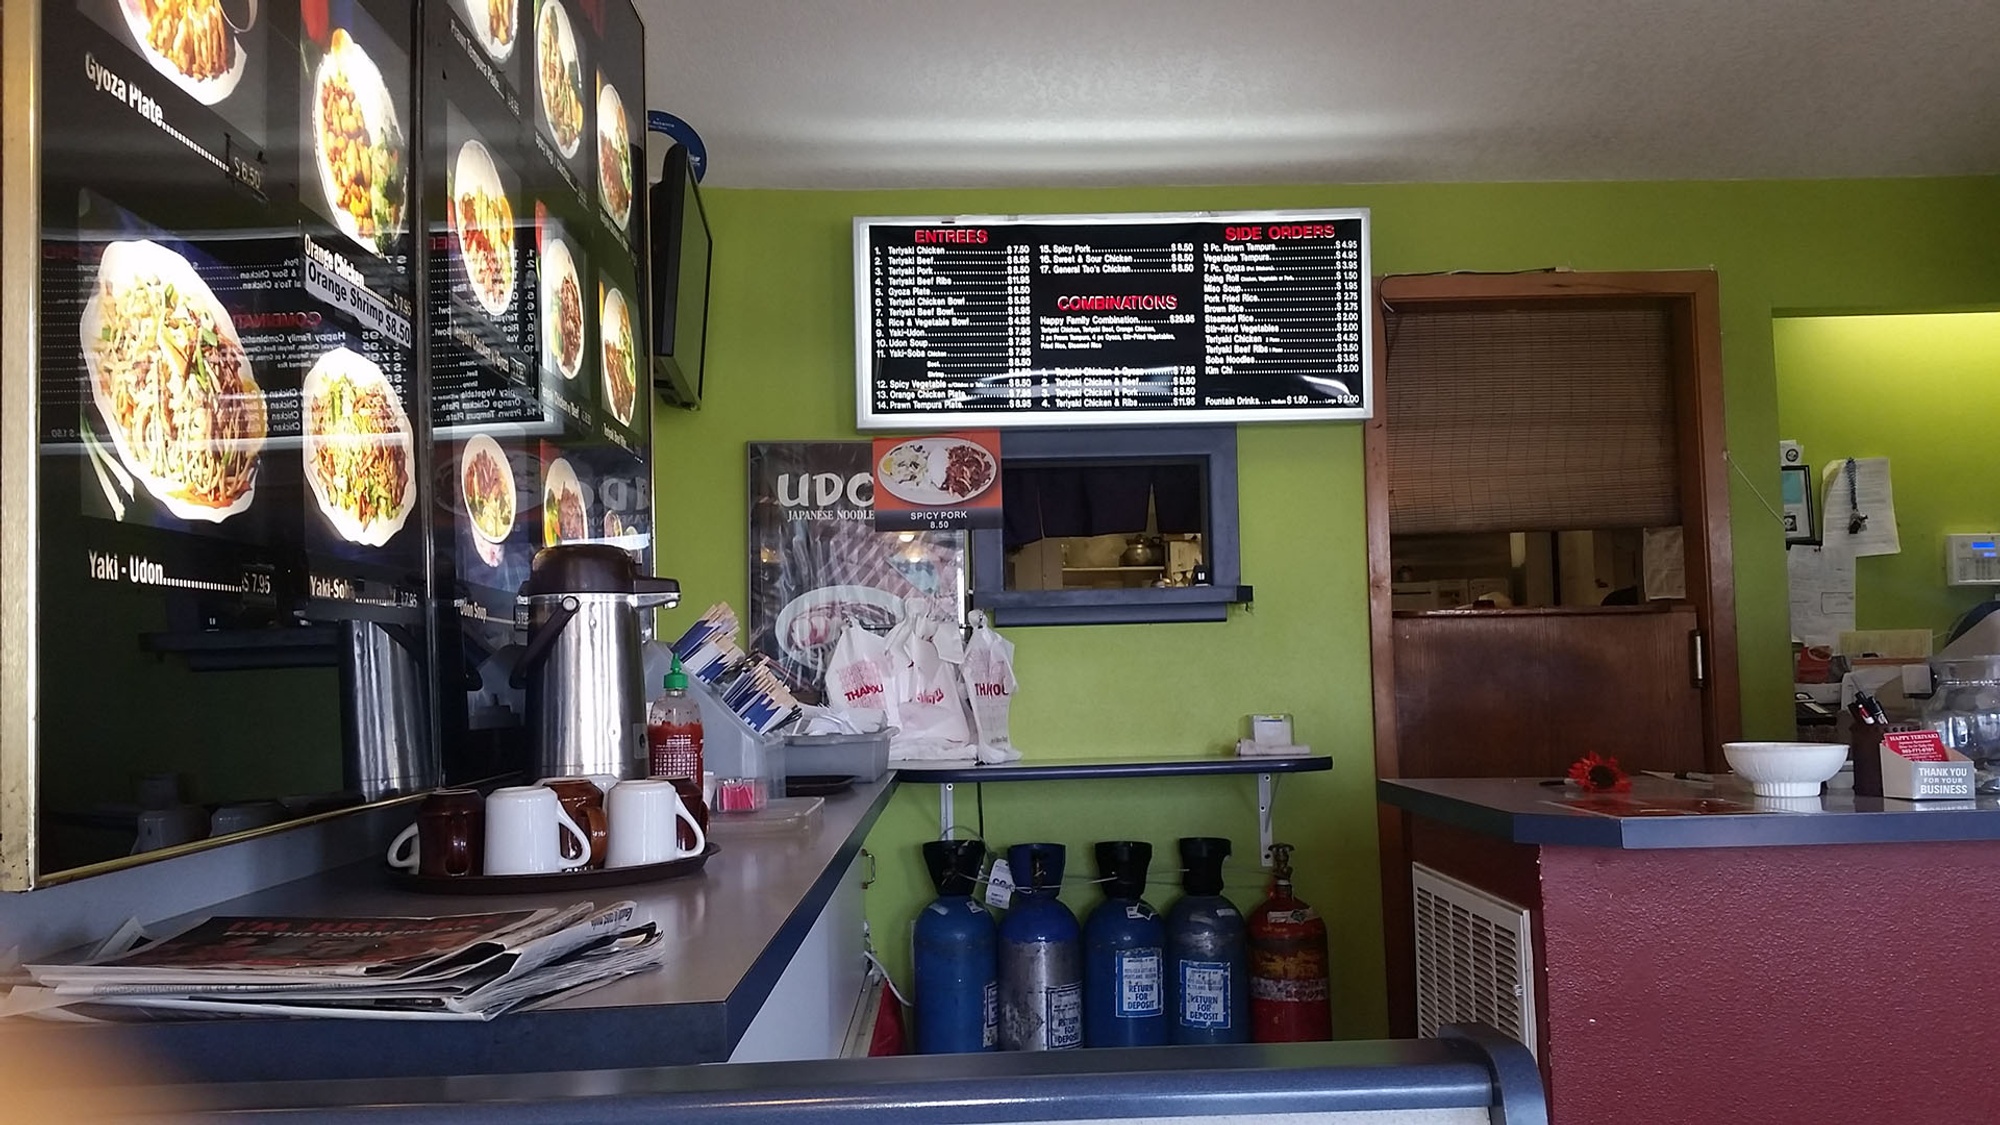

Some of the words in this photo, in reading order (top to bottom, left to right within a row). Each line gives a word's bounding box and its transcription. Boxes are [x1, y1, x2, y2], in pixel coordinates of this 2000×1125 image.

[85, 53, 127, 104] Gyoza
[129, 82, 163, 127] Plate
[914, 230, 988, 243] ENTREES
[1225, 227, 1261, 241] SIDE
[1269, 225, 1335, 239] ORDERS
[304, 234, 334, 271] Orange
[334, 253, 364, 290] Chicken
[309, 262, 347, 302] Orange
[350, 288, 384, 326] Shrimp
[386, 314, 410, 344] $8.50
[1058, 296, 1177, 310] COMBINATIONS
[788, 509, 834, 522] JAPANESE
[910, 511, 939, 522] SPICY
[941, 510, 968, 520] PORK
[930, 520, 950, 530] 8.50
[88, 550, 118, 580] Yaki
[130, 556, 164, 585] Udon
[1918, 767, 1948, 777] THANK
[1950, 767, 1968, 776] YOU
[1920, 784, 1968, 795] BUSINESS
[1128, 984, 1154, 993] RETURN
[1127, 1001, 1155, 1010] DEPOSIT
[1191, 996, 1218, 1005] RETURN
[1190, 1012, 1219, 1021] DEPOSIT
